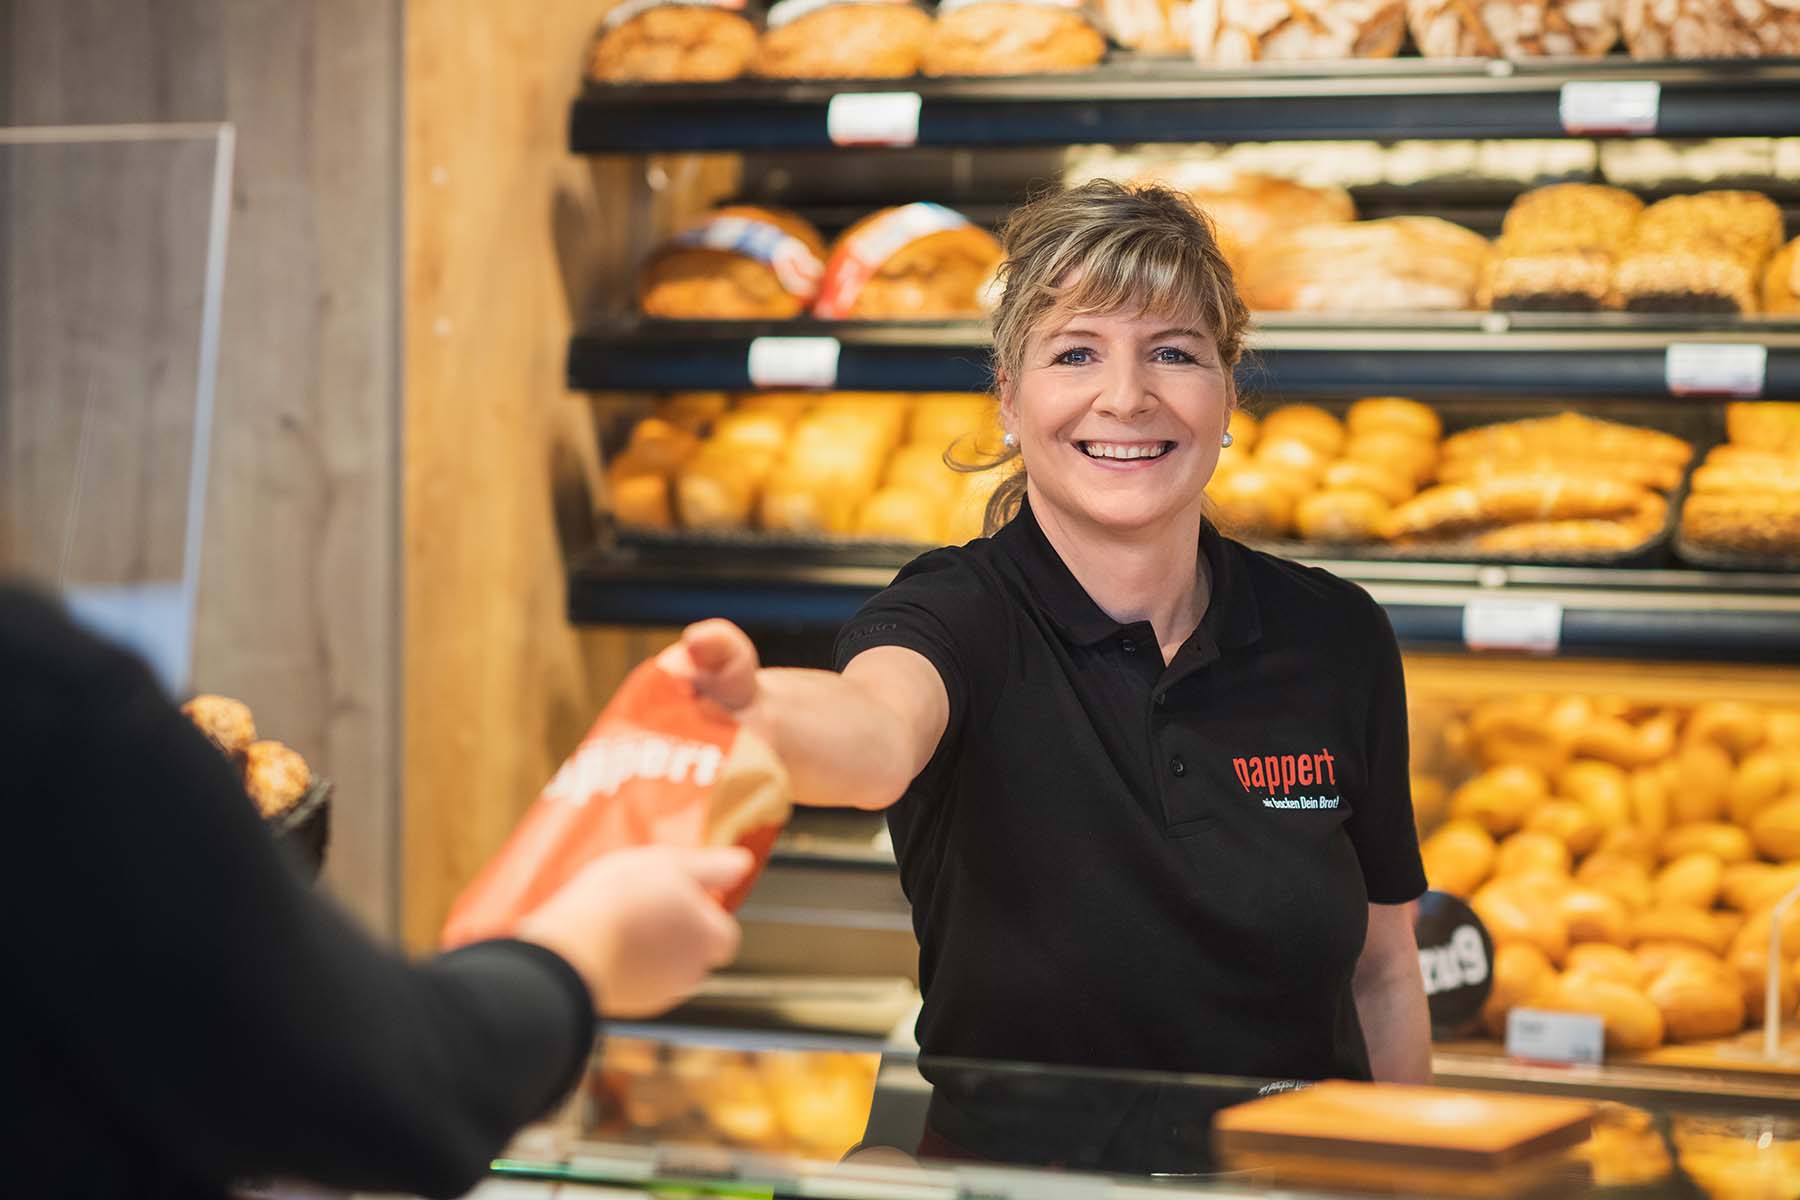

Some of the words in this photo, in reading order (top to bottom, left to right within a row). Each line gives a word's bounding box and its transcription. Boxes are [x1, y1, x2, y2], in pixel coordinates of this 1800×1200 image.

[544, 738, 722, 807] appert
[1232, 748, 1336, 795] pappert
[1300, 796, 1318, 809] Dein
[1319, 795, 1340, 809] Brot!
